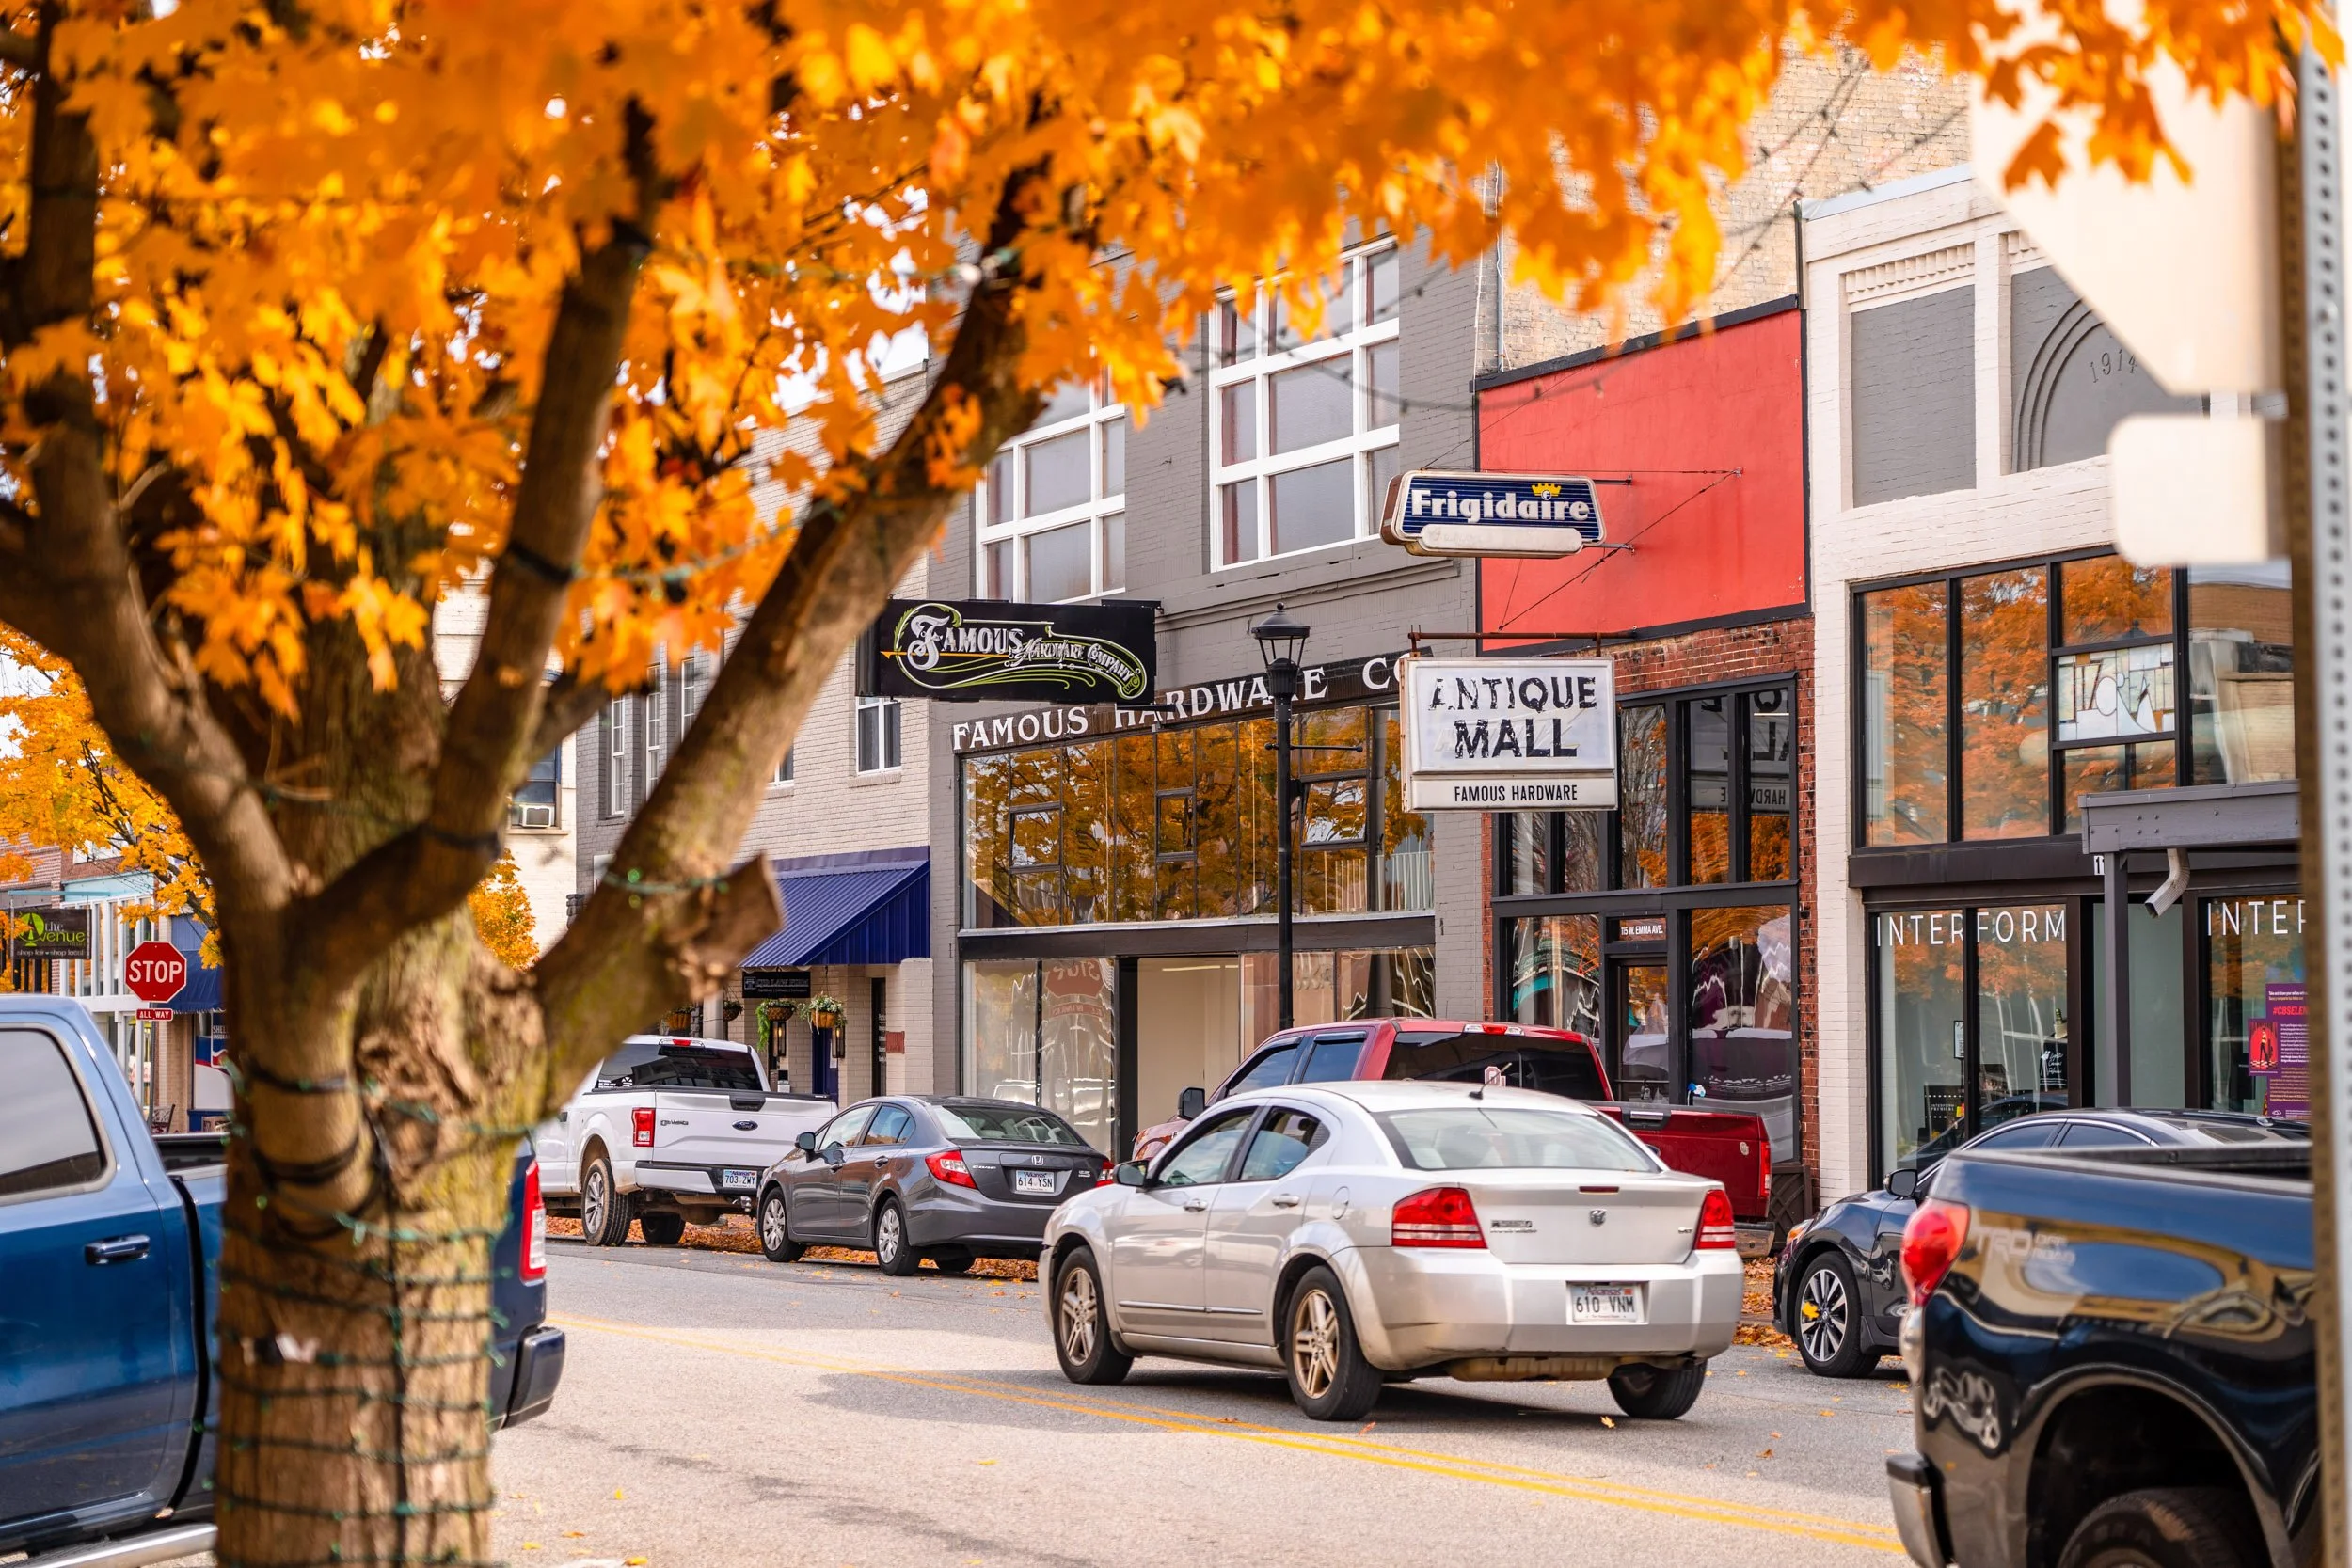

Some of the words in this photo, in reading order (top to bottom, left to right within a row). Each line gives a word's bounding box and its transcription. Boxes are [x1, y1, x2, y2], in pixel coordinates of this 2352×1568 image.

[2090, 349, 2138, 383] 1914
[1411, 489, 1590, 523] Frigidaire
[908, 615, 1024, 670] FAMOUS
[1004, 637, 1085, 667] HARDWARE
[1087, 643, 1134, 682] COMPANY
[1428, 676, 1597, 713] ANTIQUE
[953, 706, 1089, 751] FAMOUS
[1114, 666, 1328, 729] HARDWAE
[1454, 719, 1578, 759] MALL
[1454, 785, 1505, 802] FAMOUS
[1512, 784, 1578, 800] HARDWARE
[1635, 925, 1651, 935] EMMA
[1876, 909, 2066, 948] INTERFORM
[128, 959, 183, 983] STOP
[155, 1010, 169, 1019] WAY
[725, 1175, 739, 1184] 703
[742, 1176, 755, 1184] ZWY
[1018, 1177, 1033, 1186] 614
[1038, 1178, 1053, 1187] YSN
[1586, 1286, 1622, 1295] Arkansas
[1576, 1296, 1600, 1313] 610
[1608, 1296, 1634, 1313] VNM
